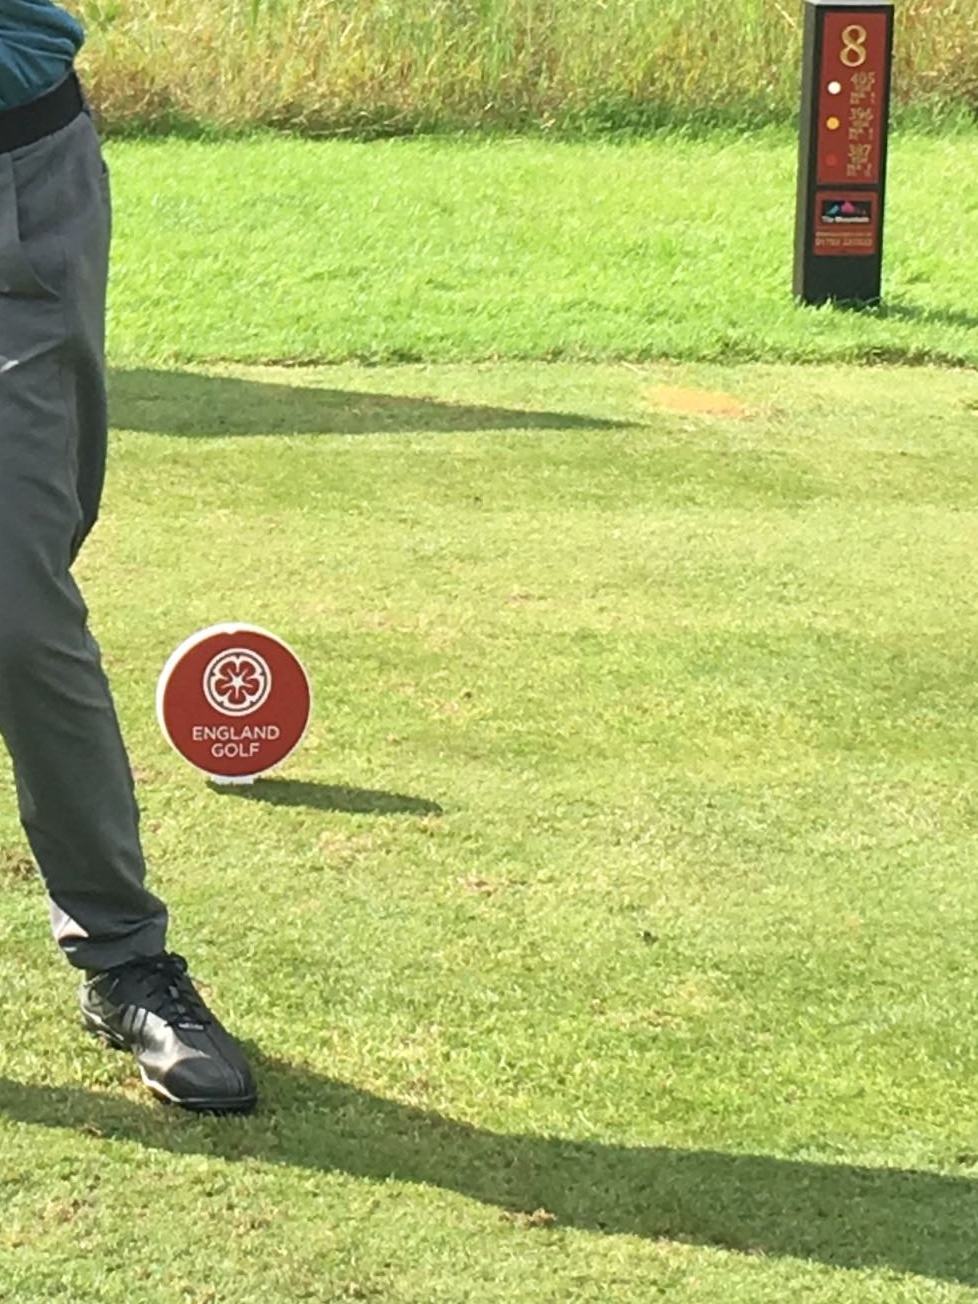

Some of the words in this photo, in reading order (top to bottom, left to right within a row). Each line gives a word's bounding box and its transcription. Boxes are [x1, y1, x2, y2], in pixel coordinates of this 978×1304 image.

[839, 24, 867, 67] 8
[191, 725, 281, 741] ENGLAND
[211, 742, 261, 758] GOLF
